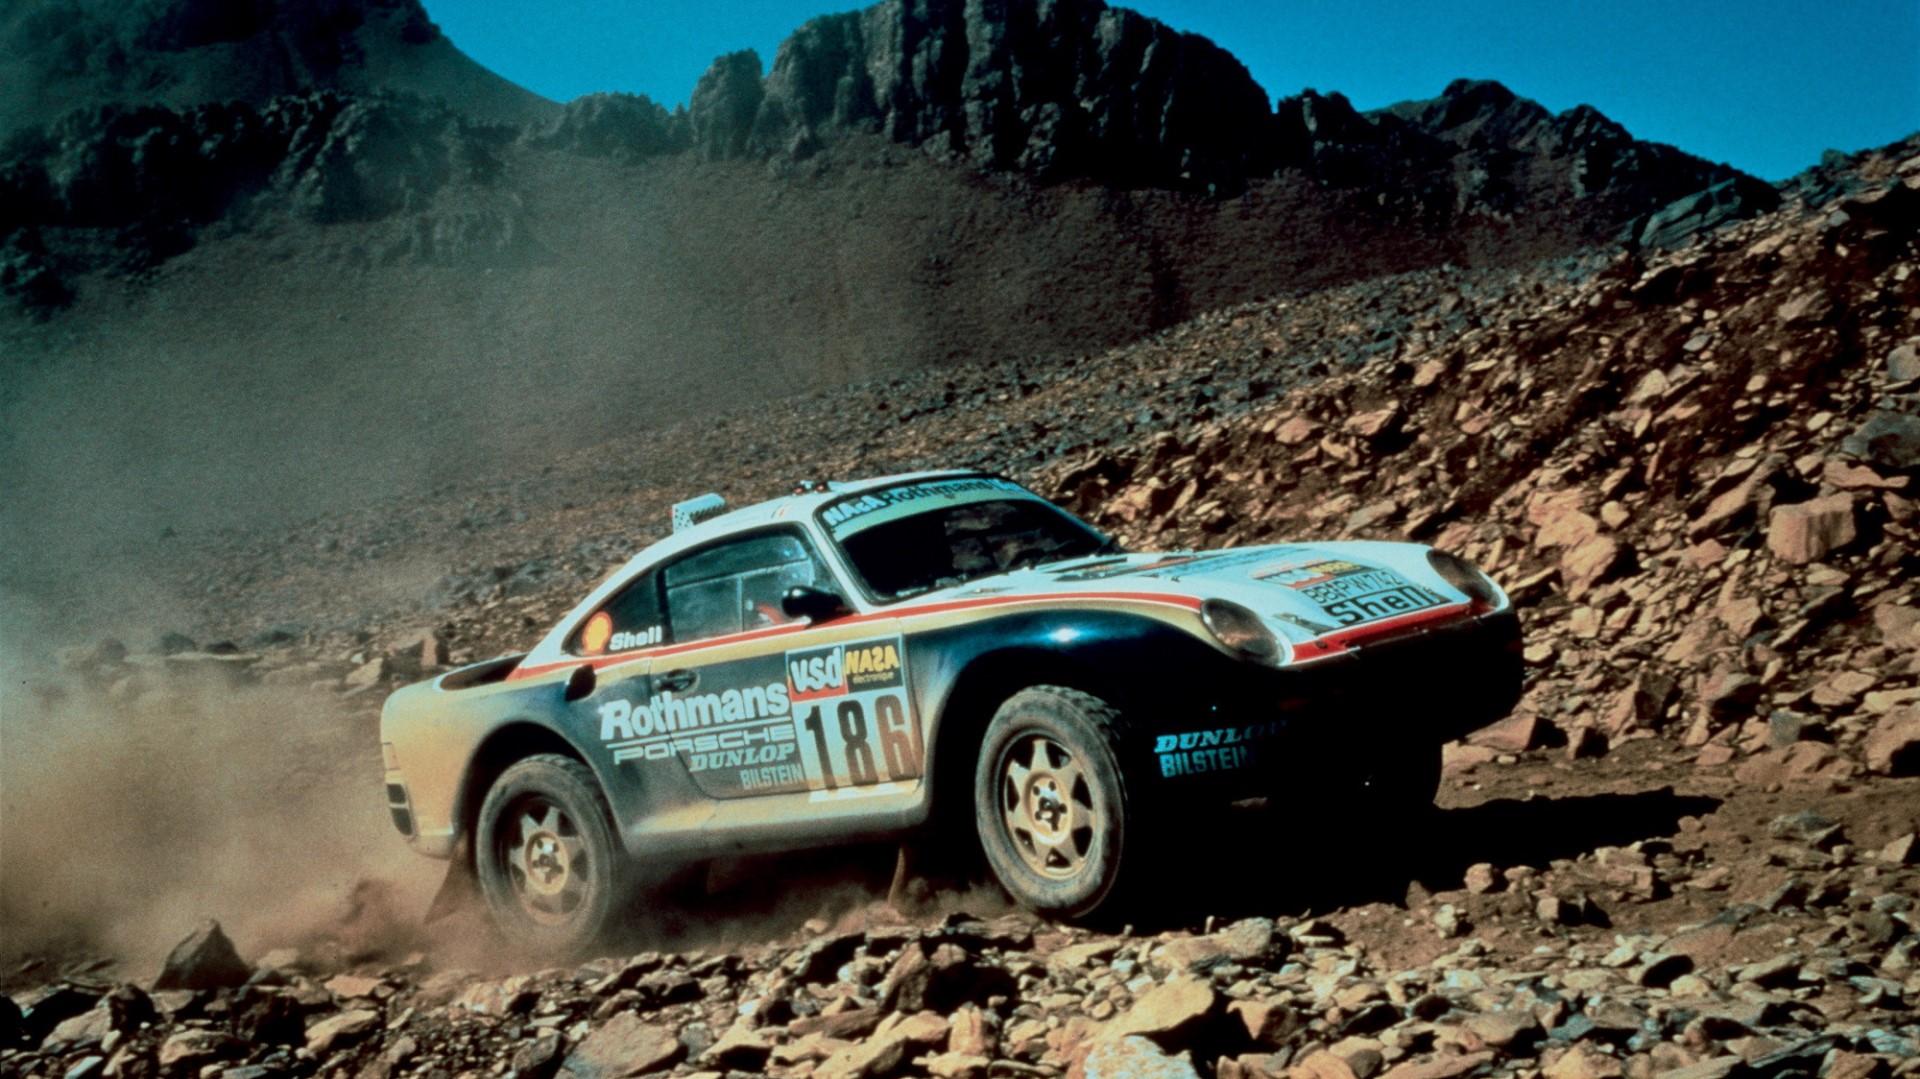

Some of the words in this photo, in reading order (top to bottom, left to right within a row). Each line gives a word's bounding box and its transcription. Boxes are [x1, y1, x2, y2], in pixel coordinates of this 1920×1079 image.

[1322, 585, 1436, 625] Shell
[610, 626, 663, 651] Shell
[598, 682, 790, 741] Rothmans
[613, 723, 796, 764] PORSCHE
[804, 694, 918, 790] 186
[1154, 723, 1266, 753] DUNL
[689, 742, 796, 772] DUNLOP
[740, 763, 804, 790] BILSTEIN
